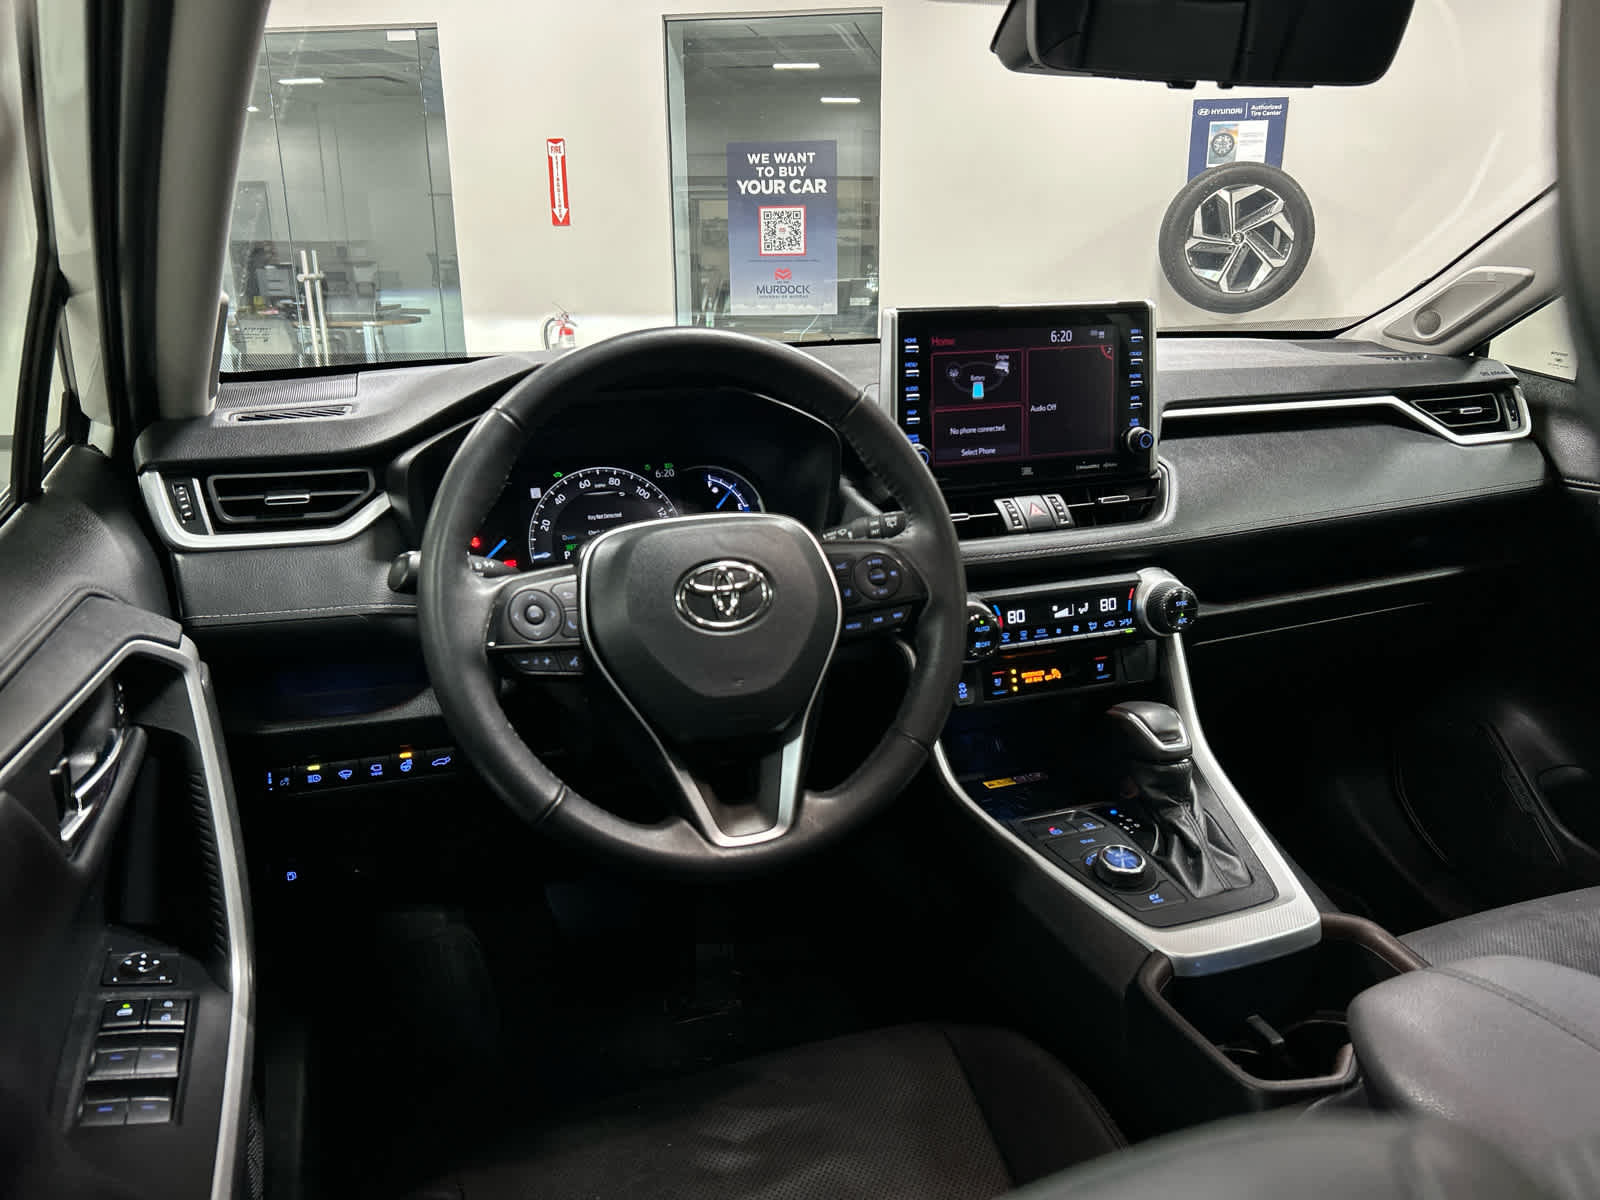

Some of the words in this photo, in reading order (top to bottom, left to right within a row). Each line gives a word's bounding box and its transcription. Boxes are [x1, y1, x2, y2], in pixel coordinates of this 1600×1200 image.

[747, 153, 770, 164] WE
[774, 152, 816, 163] WANT
[756, 166, 774, 177] TO
[779, 166, 807, 177] BUY
[737, 180, 786, 195] YOUR
[789, 179, 827, 194] CAR
[756, 285, 810, 295] MURDOCK
[1050, 330, 1073, 342] 6:20
[1030, 404, 1046, 412] Audio
[1046, 403, 1057, 411] Off
[960, 427, 977, 435] phone
[961, 449, 978, 457] Select
[979, 447, 996, 455] Phone
[655, 468, 675, 478] 6:20
[579, 479, 591, 489] 60
[608, 477, 621, 487] 80
[635, 486, 651, 500] 100
[555, 494, 566, 505] 40
[540, 519, 551, 532] 20
[564, 551, 571, 560] P
[1100, 597, 1117, 612] 80
[1007, 609, 1025, 624] 80
